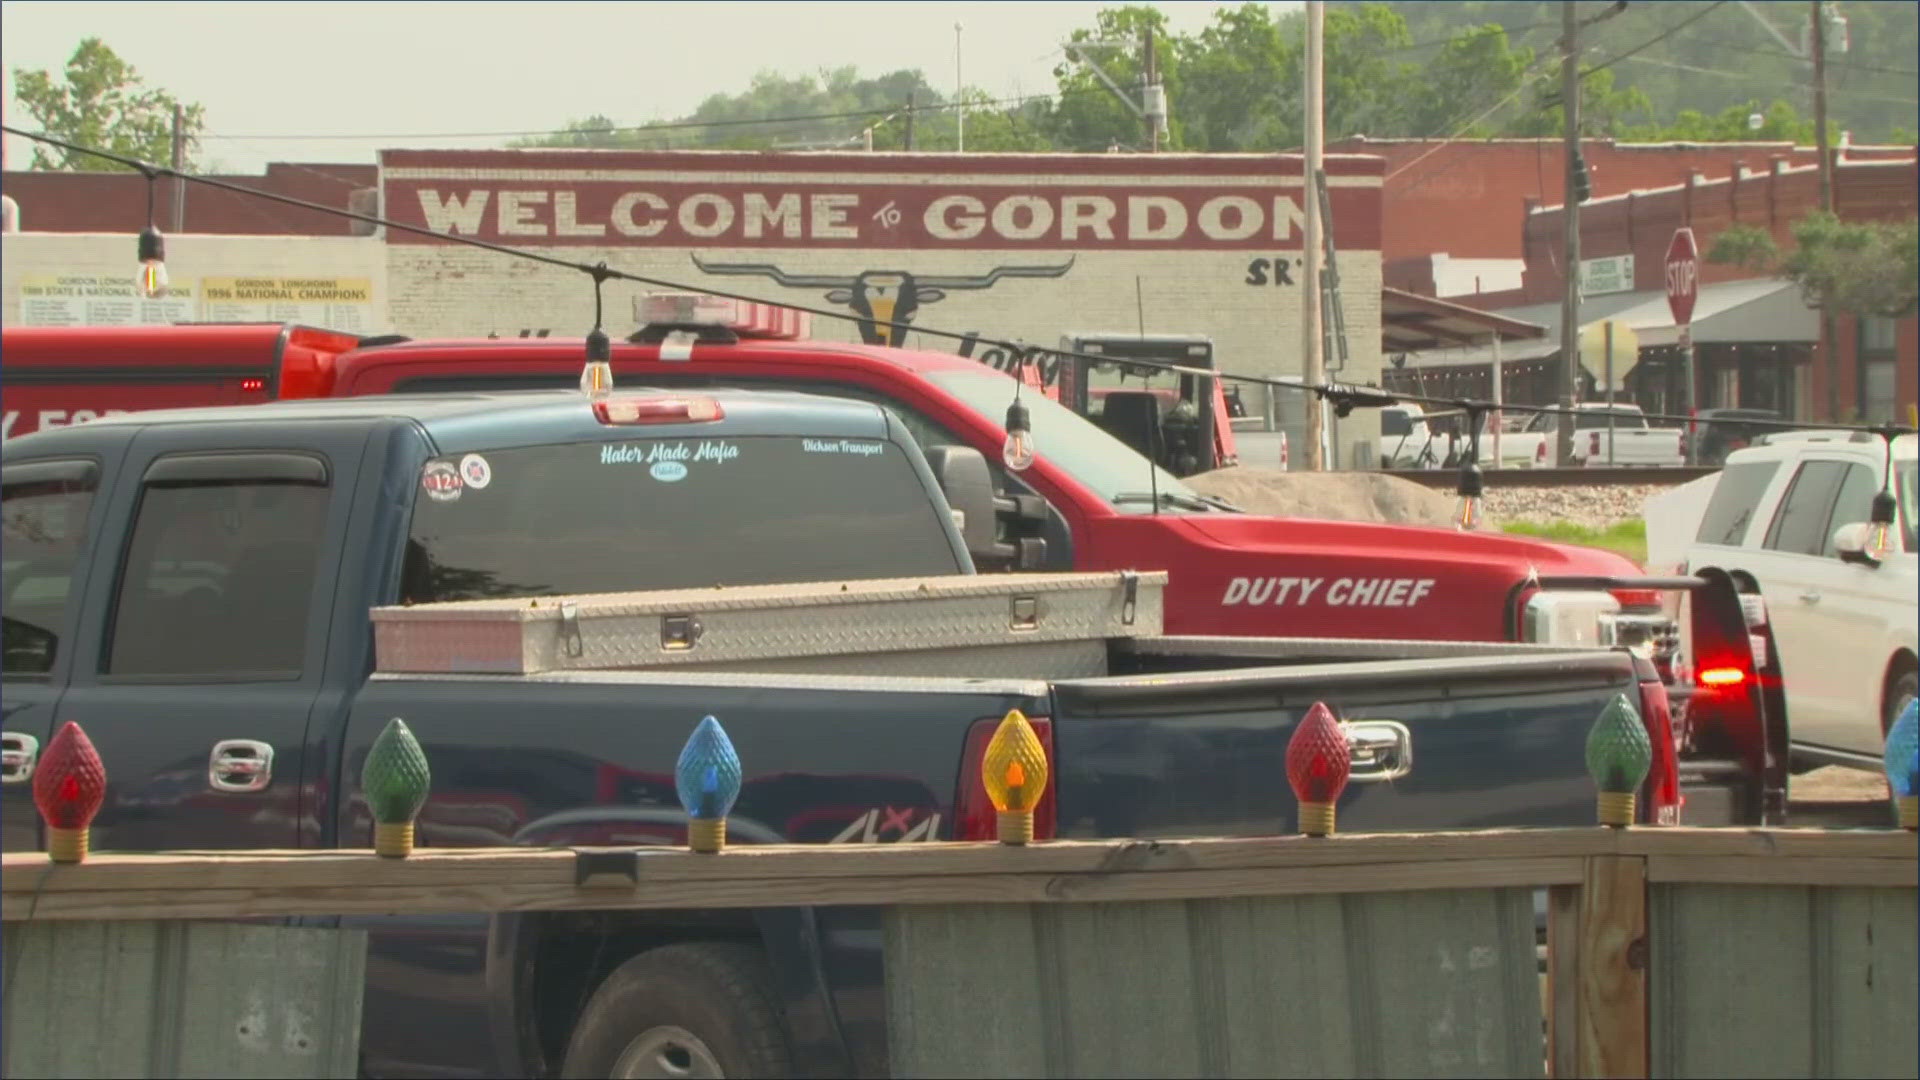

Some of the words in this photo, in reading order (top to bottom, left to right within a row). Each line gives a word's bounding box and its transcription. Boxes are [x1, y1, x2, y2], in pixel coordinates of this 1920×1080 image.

[417, 189, 859, 239] WELCOME
[923, 194, 1305, 241] GORDON
[57, 277, 98, 286] GORDON
[235, 279, 275, 288] GORDON
[280, 279, 337, 288] LONGHORNS
[1668, 260, 1695, 296] STOP
[45, 287, 75, 296] STATE
[86, 287, 133, 297] NATIONAL
[207, 288, 232, 299] 1996
[236, 289, 293, 299] NATIONAL
[298, 289, 366, 300] CHAMPIONS
[600, 444, 644, 464] Hater
[646, 442, 692, 463] Made
[693, 440, 740, 464] Mafia
[840, 440, 883, 457] Transport
[1221, 577, 1324, 606] DUTY
[1325, 578, 1436, 607] CHIEF
